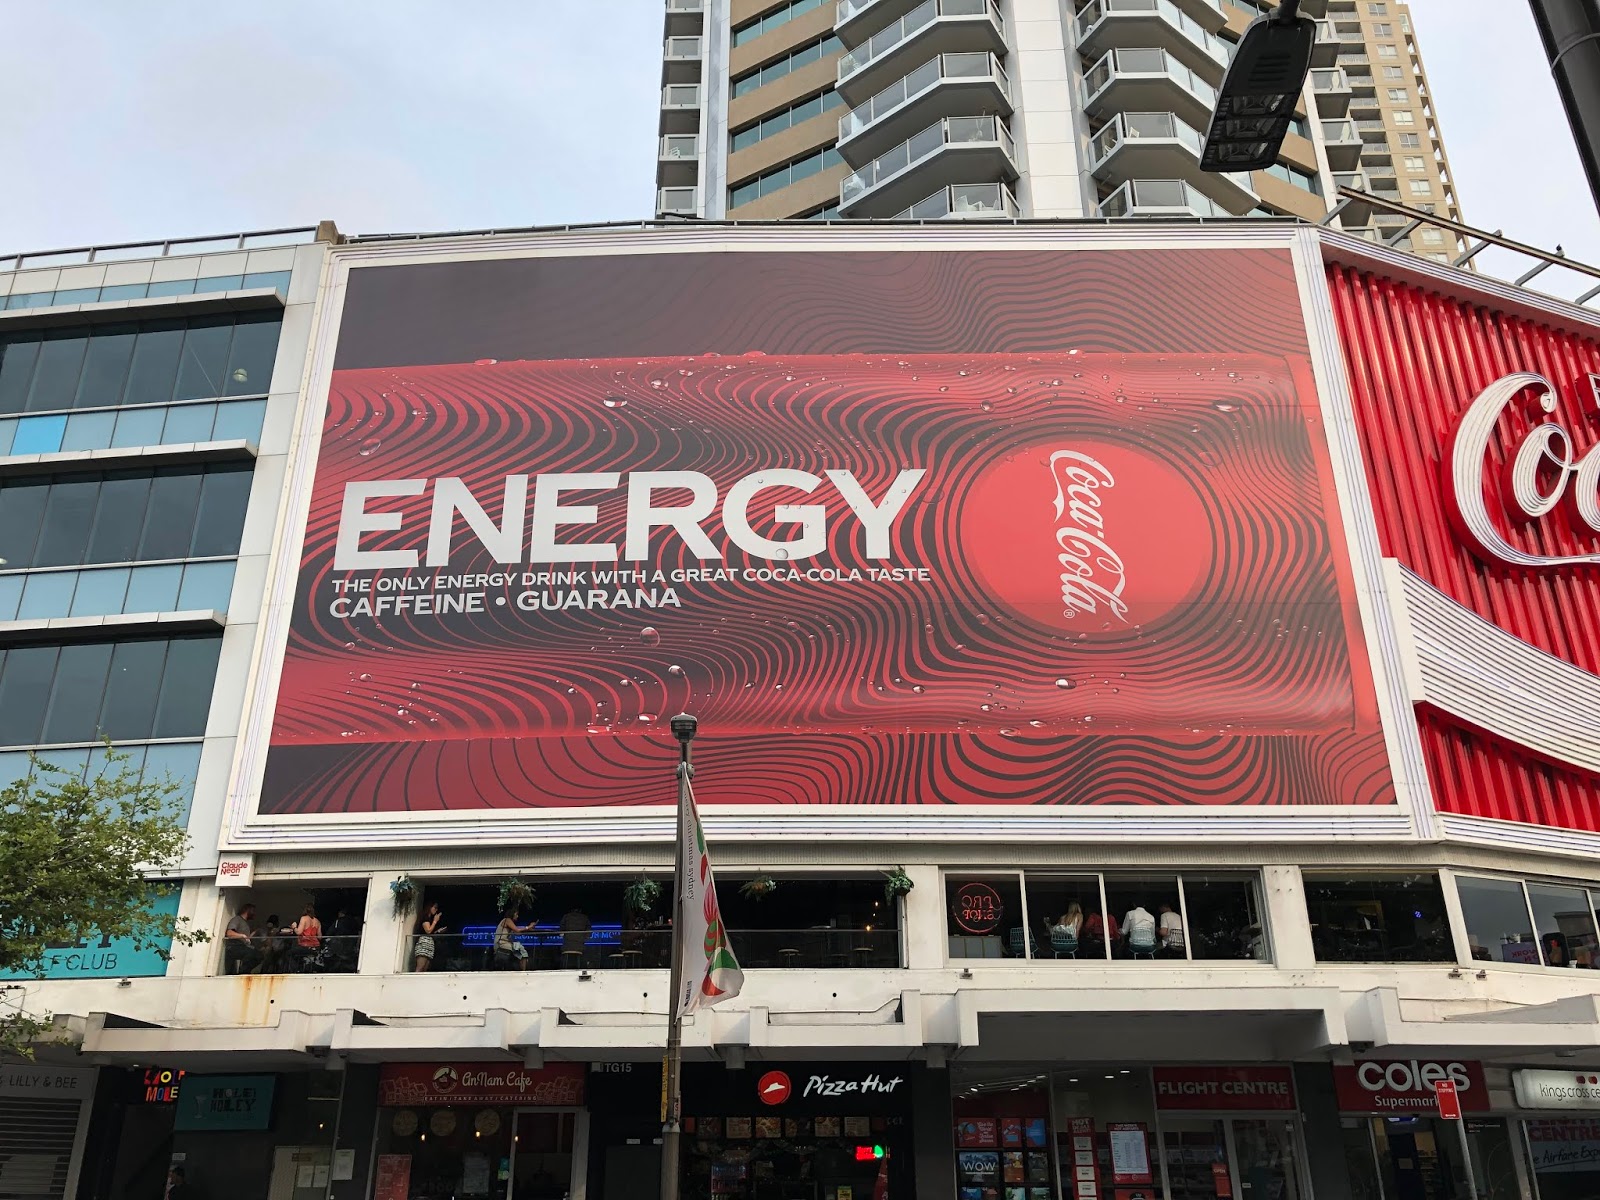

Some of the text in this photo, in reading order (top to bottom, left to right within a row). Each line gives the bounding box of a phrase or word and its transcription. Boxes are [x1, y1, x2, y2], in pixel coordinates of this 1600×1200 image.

[333, 468, 927, 571] ENERGY
[331, 567, 931, 593] THE ONLY ENERGY DRINK WITH A GREAT COCA-COLA TASTE
[329, 587, 682, 619] CAFFEINE GUARANA
[221, 861, 248, 869] Claude
[687, 867, 695, 900] sydney
[65, 953, 118, 971] CLUB
[9, 1075, 40, 1087] LILLY
[55, 1076, 78, 1088] BEE
[506, 1071, 533, 1093] Cafe
[1357, 1060, 1471, 1092] coles
[803, 1074, 903, 1098] Pizza Hut
[1158, 1081, 1288, 1096] FLIGHT CENTRE
[1539, 1083, 1566, 1101] kings
[1567, 1087, 1590, 1098] cross
[1528, 1125, 1600, 1141] CENTRE
[1543, 1148, 1579, 1163] Airfare
[1581, 1145, 1600, 1160] Exp
[962, 1161, 996, 1171] WOW
